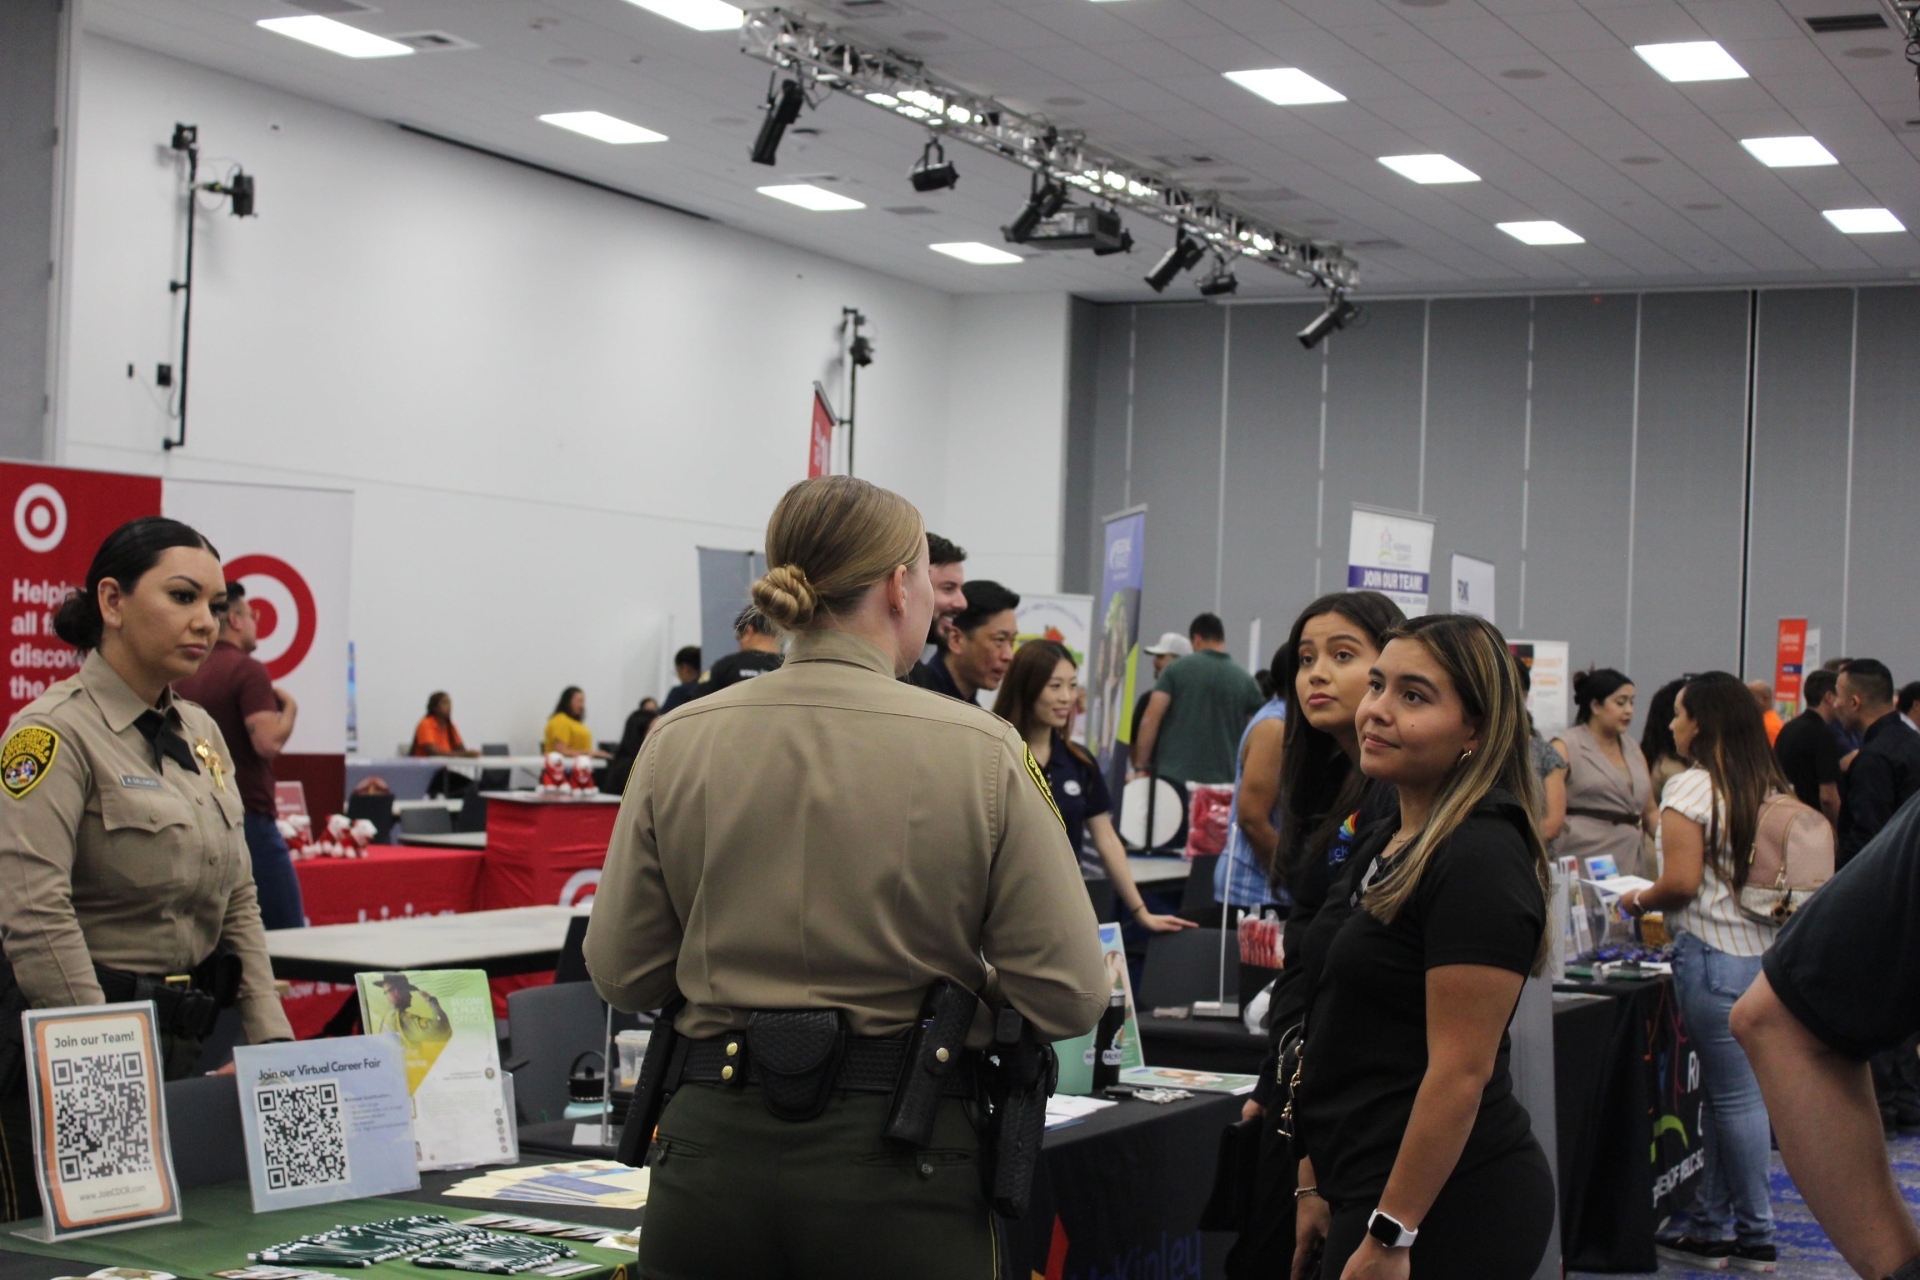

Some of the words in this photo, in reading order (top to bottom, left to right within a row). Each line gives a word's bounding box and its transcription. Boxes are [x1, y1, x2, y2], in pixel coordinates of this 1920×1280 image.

[11, 611, 37, 636] all
[54, 1035, 78, 1048] Join
[81, 1036, 99, 1046] our
[101, 1031, 135, 1044] Team!
[258, 1069, 278, 1080] Join
[280, 1069, 296, 1078] our
[297, 1062, 330, 1076] Virtual
[331, 1060, 362, 1072] Career
[363, 1057, 381, 1069] Fair
